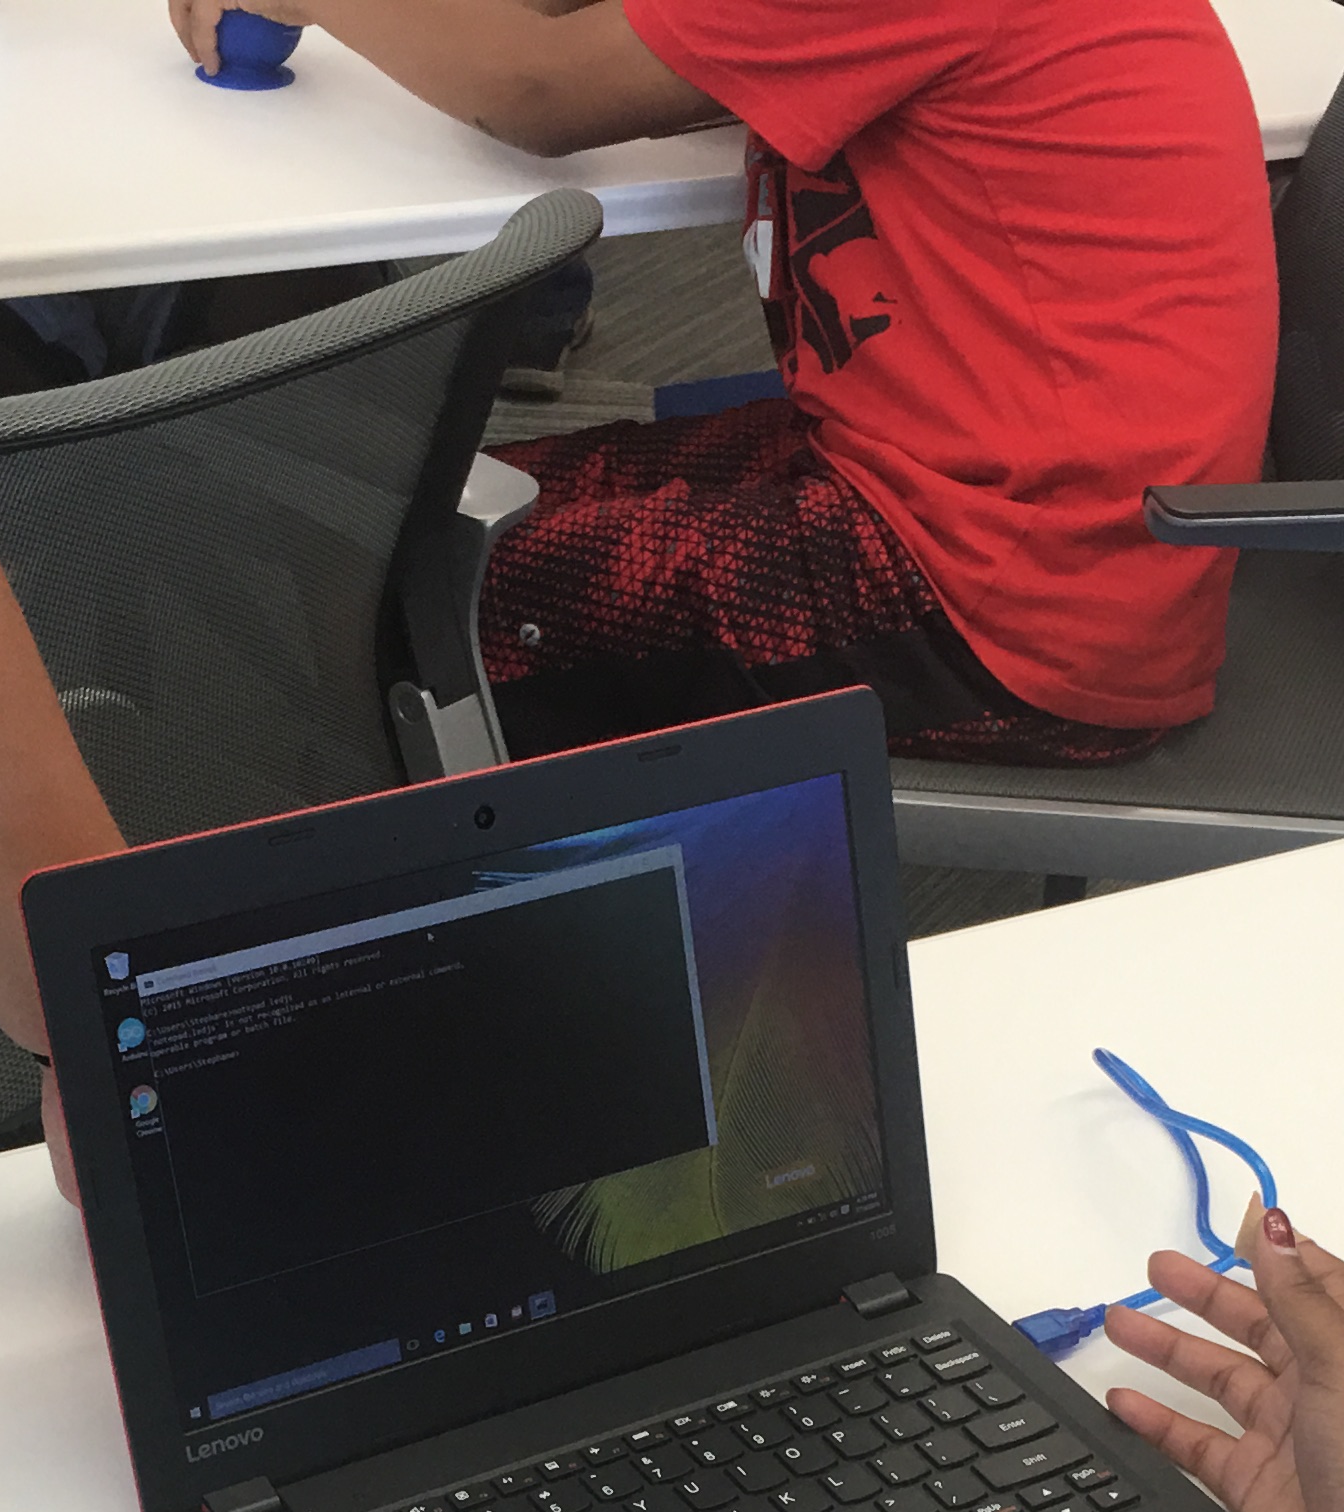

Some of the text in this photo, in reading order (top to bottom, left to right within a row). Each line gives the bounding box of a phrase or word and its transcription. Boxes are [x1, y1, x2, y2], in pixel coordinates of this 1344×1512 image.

[766, 1164, 814, 1188] Lenovo
[922, 1330, 952, 1344] Delete
[934, 1351, 980, 1372] Backspace
[999, 1417, 1026, 1432] Enter
[185, 1427, 265, 1463] Lenovo
[1022, 1453, 1048, 1467] Shift
